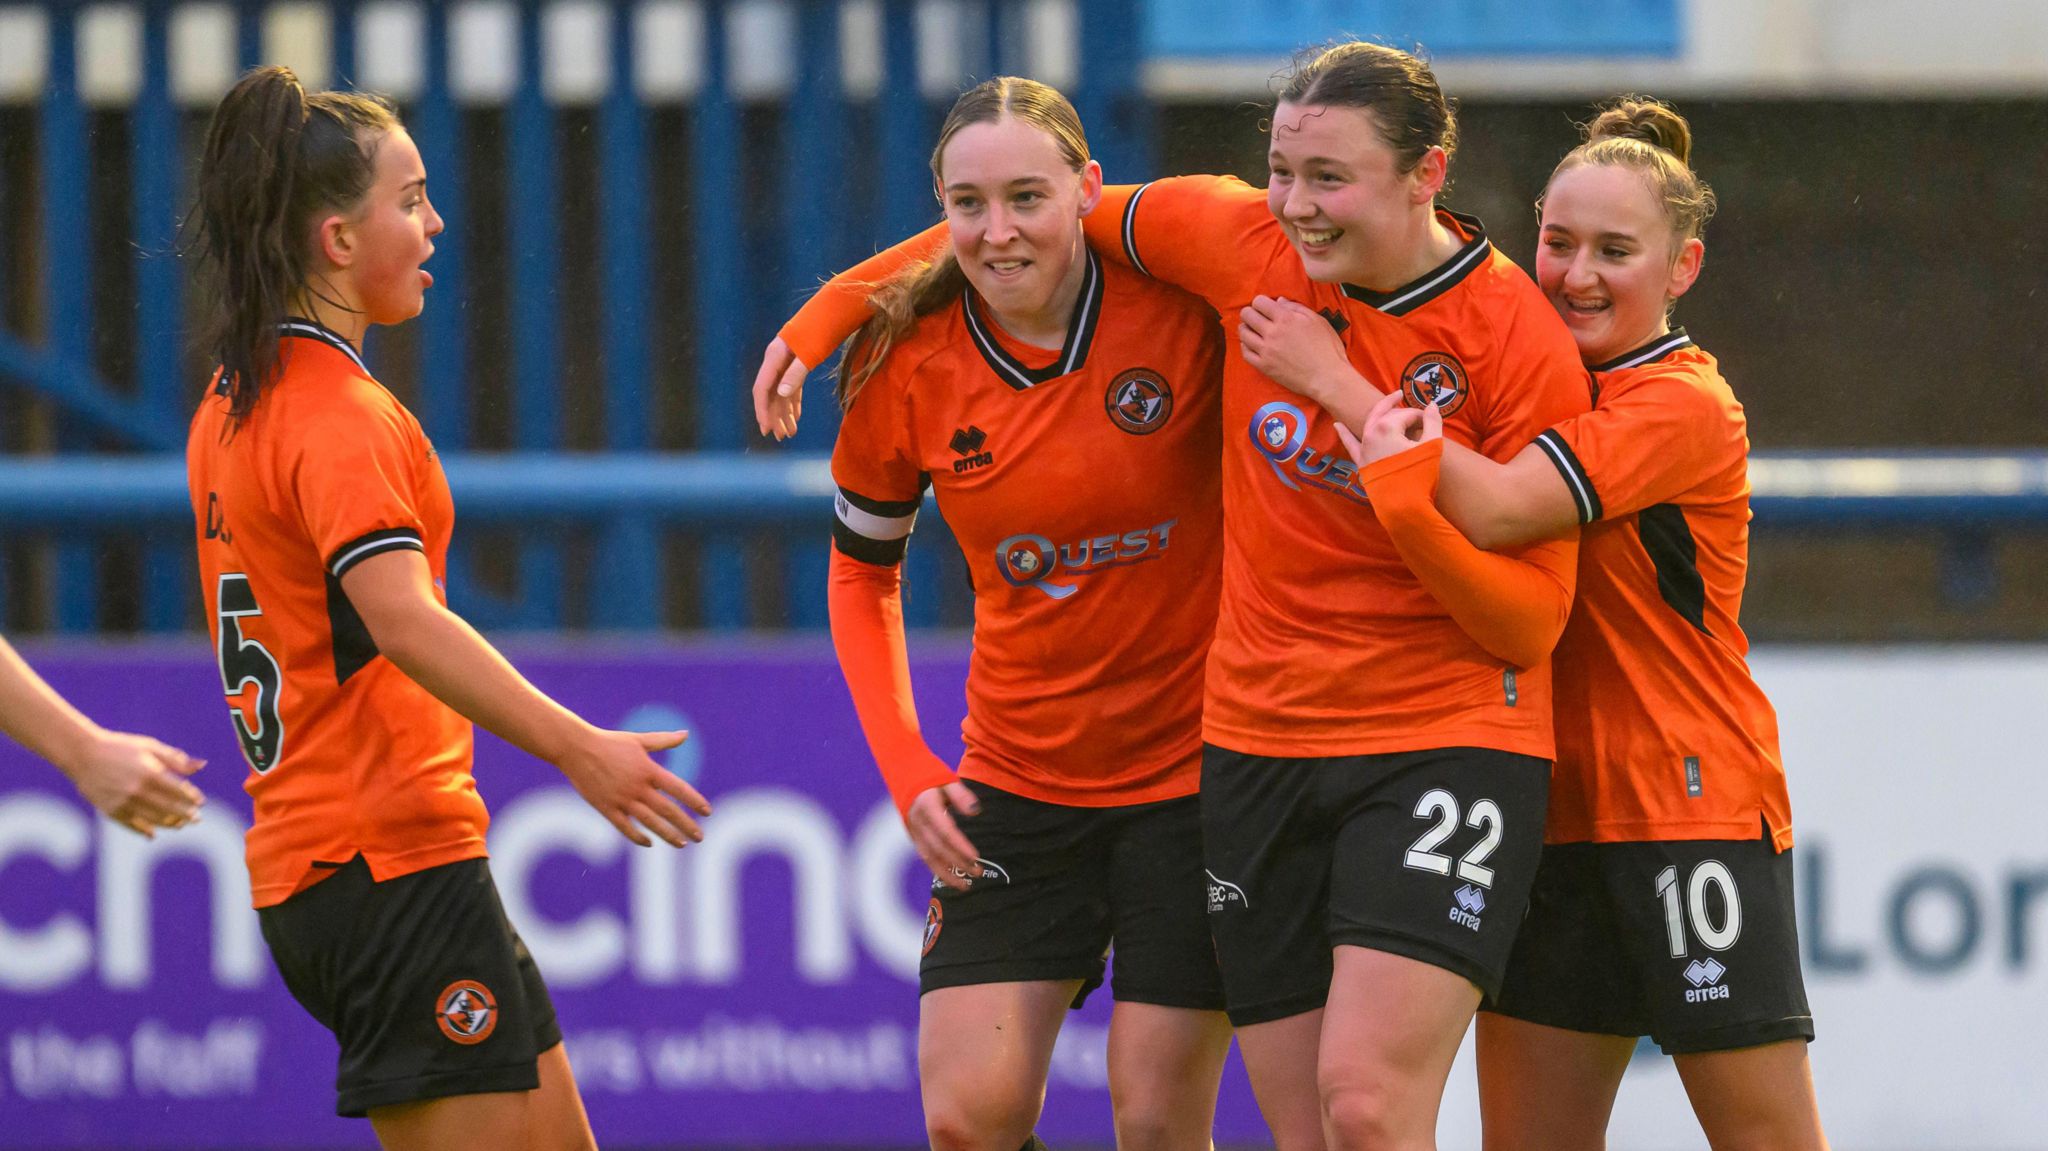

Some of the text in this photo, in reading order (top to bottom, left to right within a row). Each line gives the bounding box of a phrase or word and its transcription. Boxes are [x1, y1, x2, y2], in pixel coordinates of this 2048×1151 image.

[995, 517, 1179, 600] QUEST
[217, 572, 285, 777] 5
[982, 869, 998, 878] Fife
[1403, 788, 1504, 889] 22
[1655, 859, 1743, 958] 10
